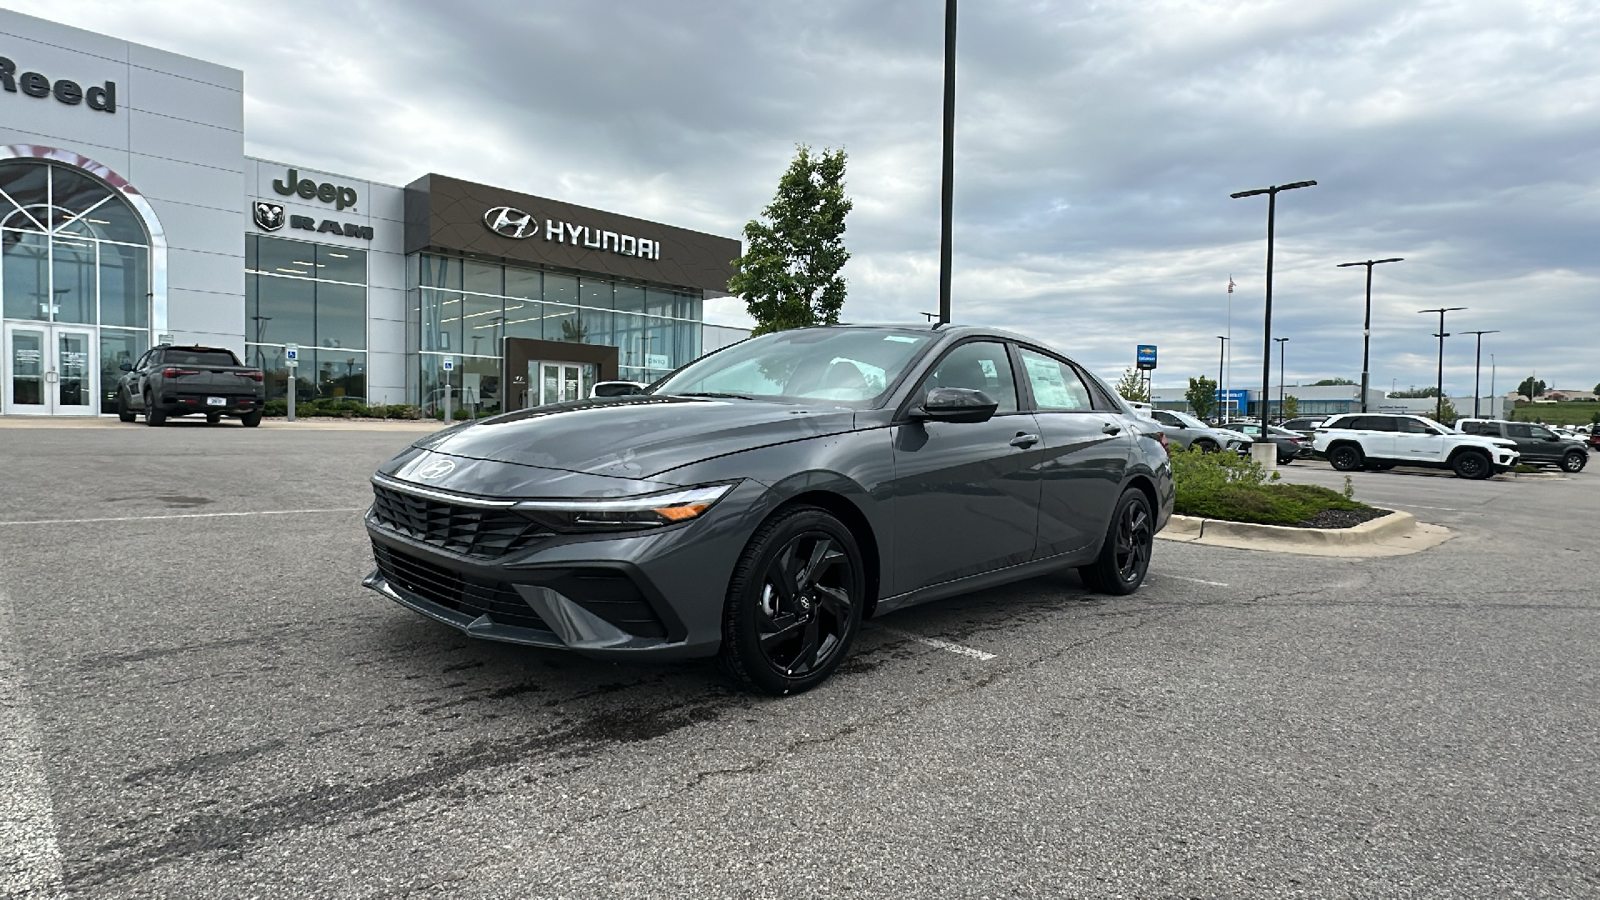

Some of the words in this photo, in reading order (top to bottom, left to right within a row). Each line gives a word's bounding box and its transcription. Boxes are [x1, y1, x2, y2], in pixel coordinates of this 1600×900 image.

[273, 168, 358, 211] Jeep
[290, 214, 374, 240] RAM
[545, 219, 660, 261] HYUNDAI
